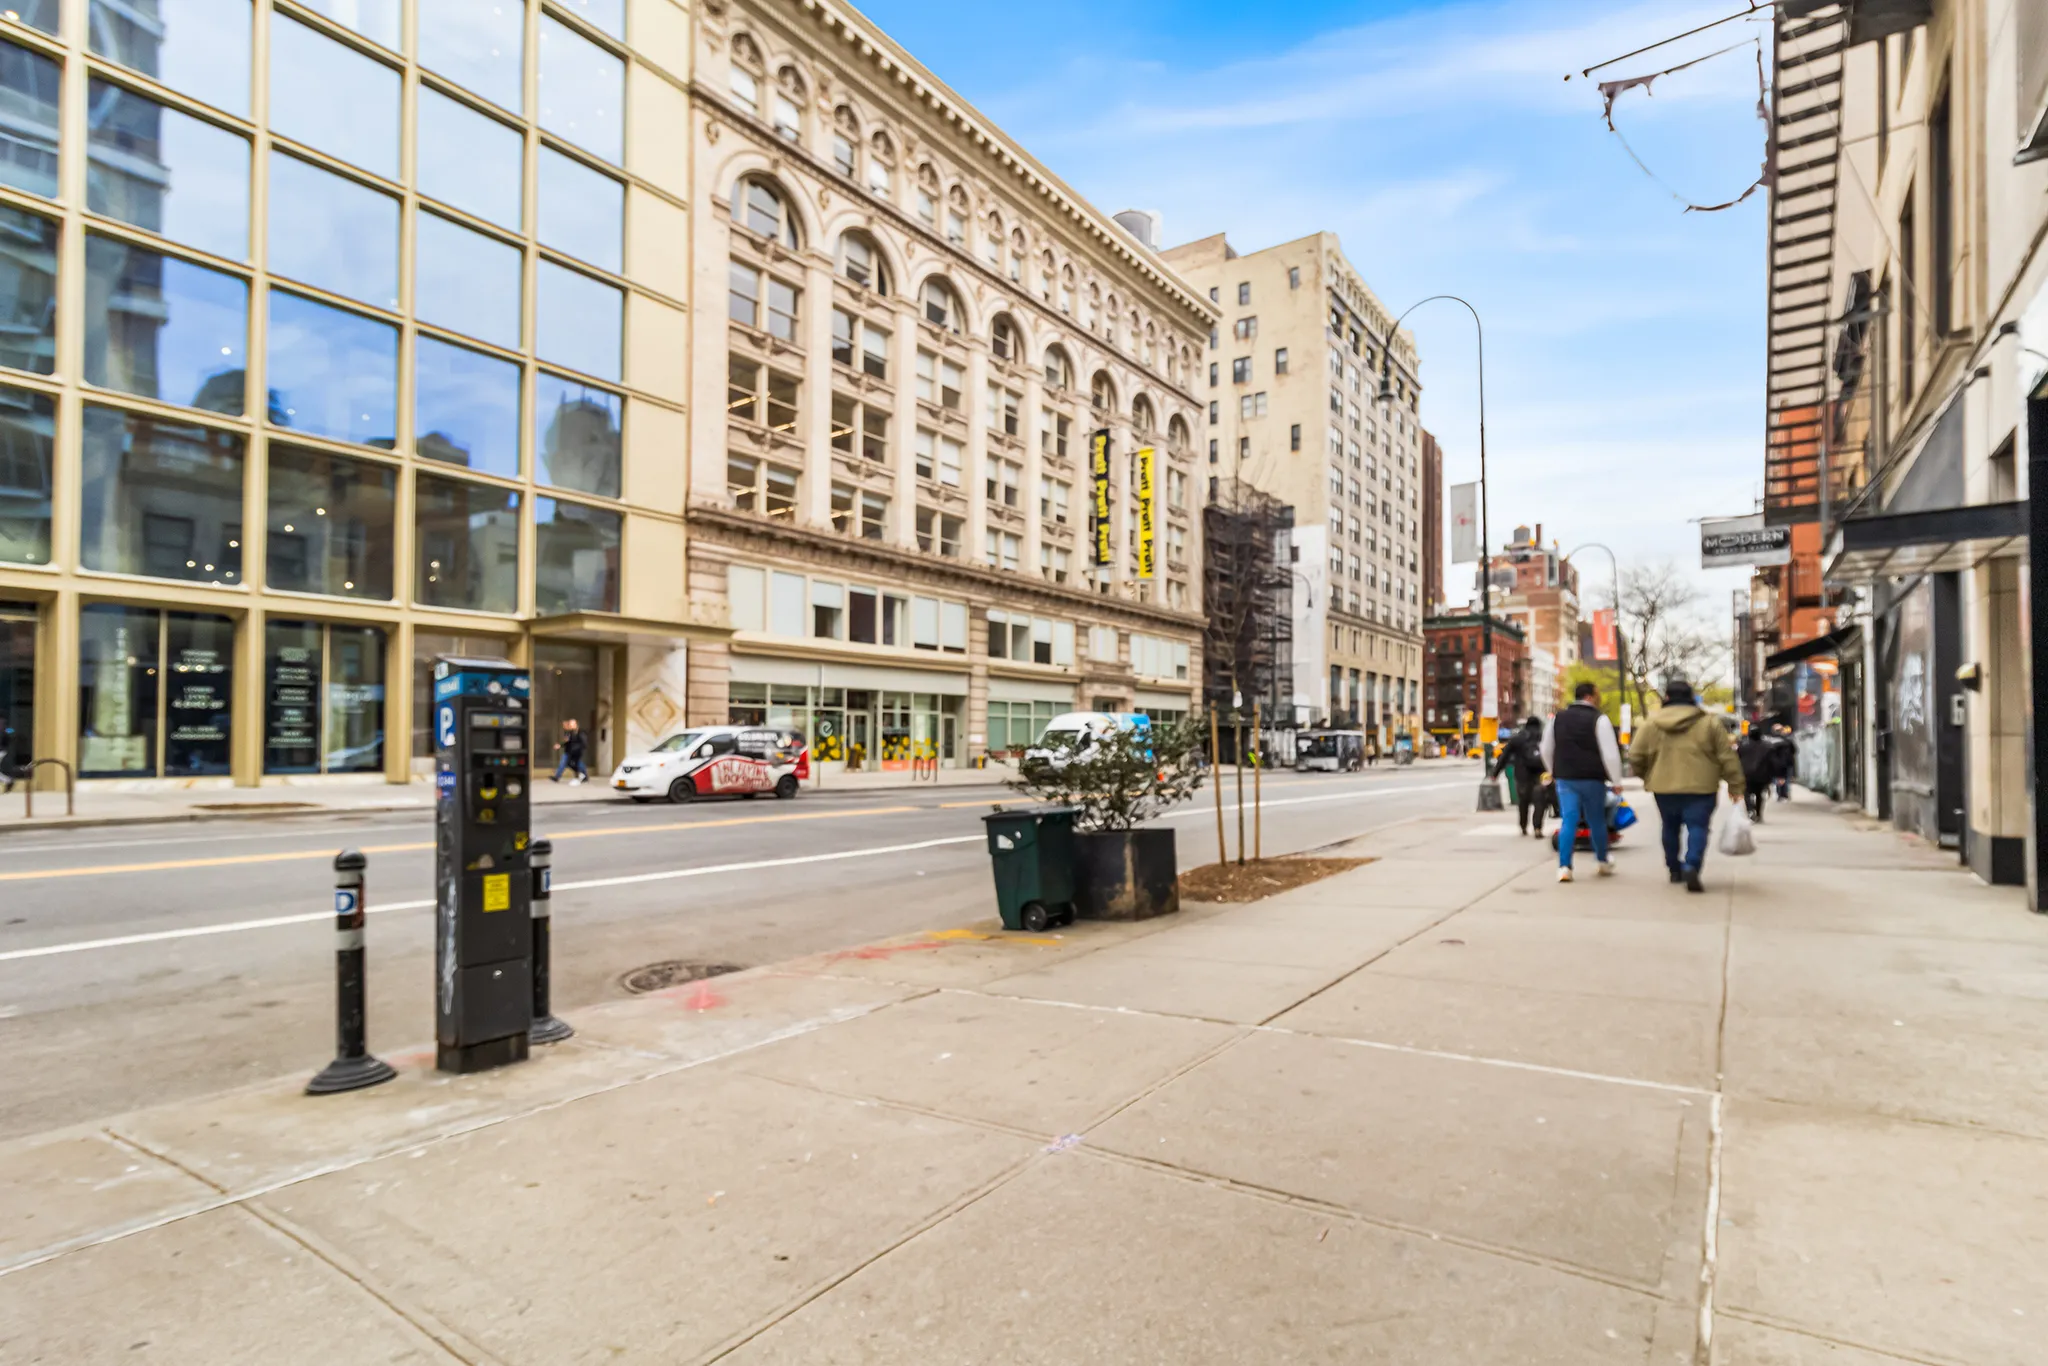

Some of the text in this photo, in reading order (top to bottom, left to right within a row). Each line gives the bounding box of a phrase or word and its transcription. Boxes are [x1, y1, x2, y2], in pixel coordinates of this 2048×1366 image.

[1140, 457, 1154, 573] Pratt Pratt Pratt
[1705, 530, 1784, 548] MODERN
[440, 707, 453, 745] P
